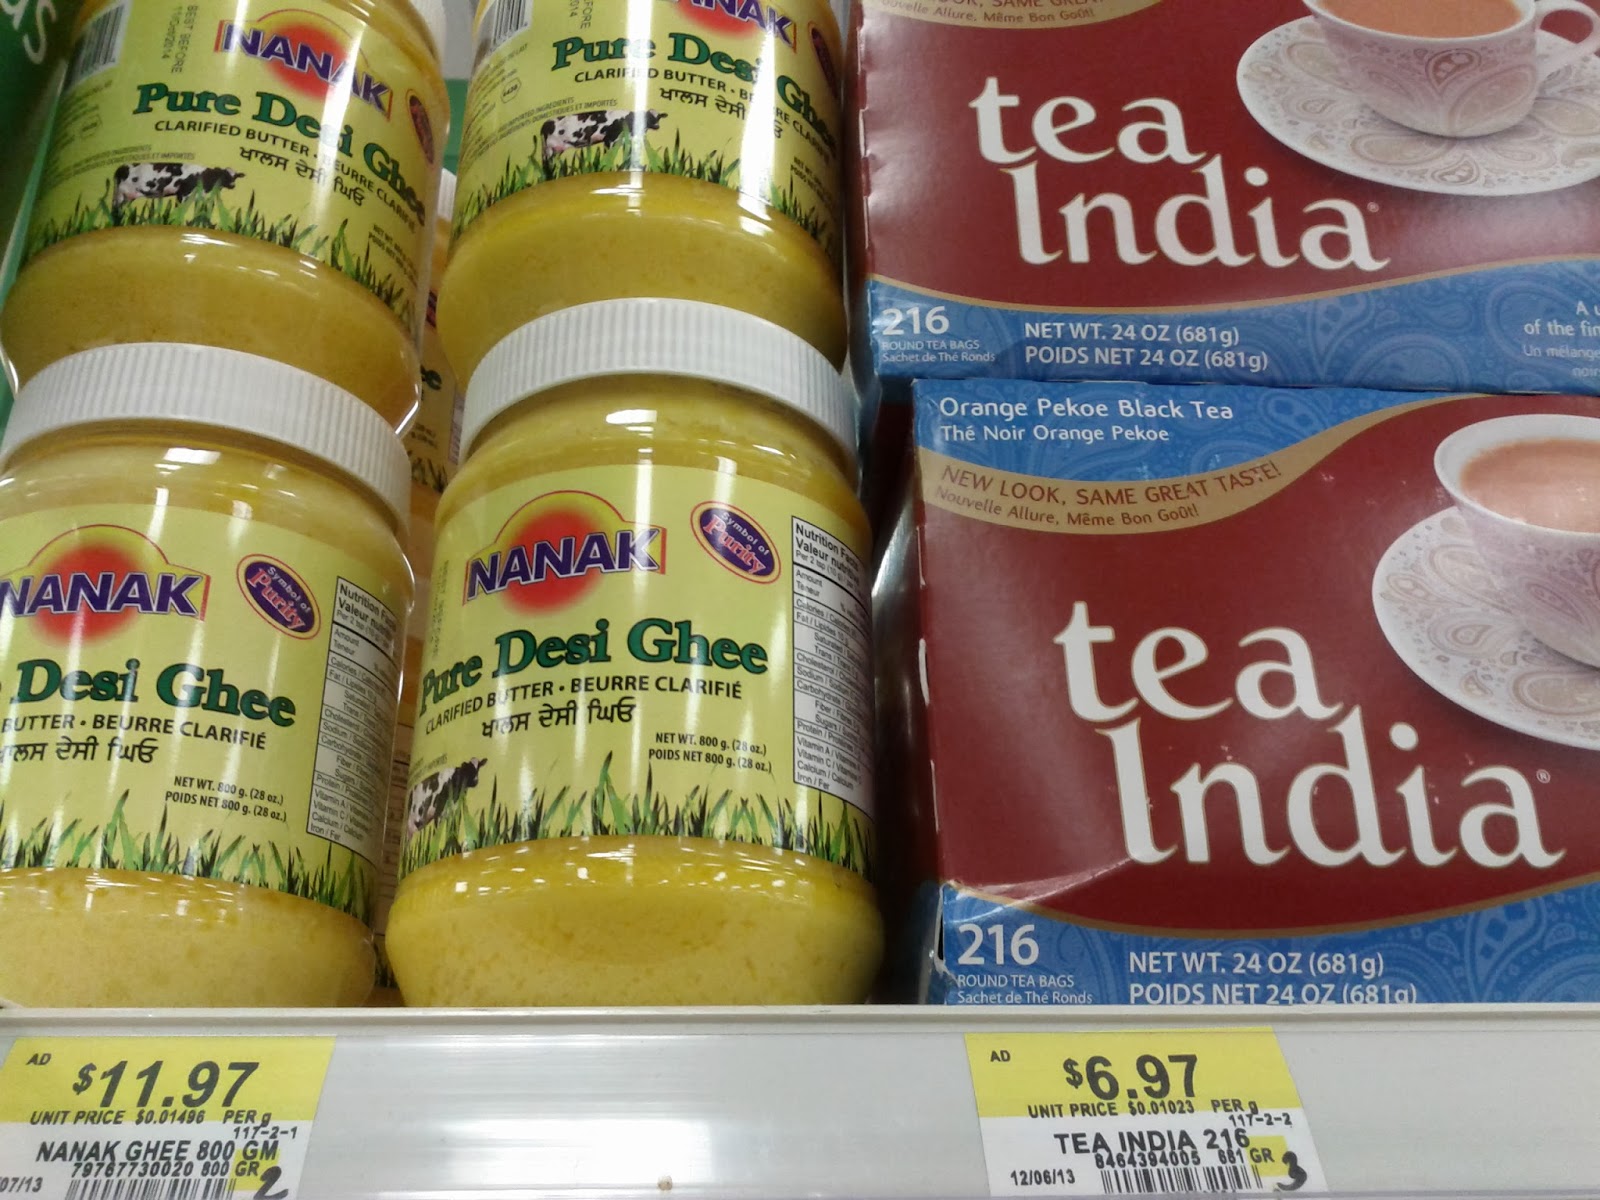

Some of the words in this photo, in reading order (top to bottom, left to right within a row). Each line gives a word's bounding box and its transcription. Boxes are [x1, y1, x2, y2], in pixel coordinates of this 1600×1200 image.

[222, 23, 389, 114] NANAK
[664, 69, 726, 93] BUTTER
[133, 82, 242, 115] Pure
[969, 76, 1206, 164] tea
[155, 120, 241, 137] CLARIFIED
[246, 128, 309, 157] BUTTER
[1000, 154, 1391, 272] India
[881, 305, 950, 336] 216
[1576, 300, 1590, 316] A
[1024, 322, 1065, 339] NET
[1070, 323, 1106, 341] WT.
[1113, 325, 1137, 341] 24
[1141, 325, 1171, 343] OZ
[1176, 326, 1239, 348] (681g)
[1523, 318, 1541, 335] of
[1547, 319, 1575, 336] the
[881, 351, 920, 363] Sachet
[921, 352, 936, 363] de
[937, 352, 959, 363] Thé
[960, 352, 996, 364] Ronds
[882, 340, 925, 350] ROUND
[927, 341, 949, 350] TEA
[950, 340, 980, 351] BAGS
[1024, 346, 1089, 365] POIDS
[1095, 348, 1135, 366] NET
[1139, 349, 1164, 366] 24
[1167, 349, 1200, 368] OZ
[1204, 350, 1269, 373] (681g)
[939, 397, 1028, 422] Orange
[1037, 397, 1109, 417] Pekoe
[1118, 399, 1183, 418] Black
[1190, 400, 1233, 420] Tea
[940, 424, 976, 442] Thé
[983, 425, 1026, 441] Noir
[1033, 425, 1104, 444] Orange
[1112, 425, 1170, 442] Pekoe
[940, 464, 995, 492] NEW
[1000, 479, 1066, 505] LOOK,
[1075, 487, 1138, 506] SAME
[1144, 479, 1209, 503] GREAT
[1214, 460, 1283, 490] TASTE!
[935, 485, 1003, 516] Nouvelle
[1007, 504, 1060, 526] Allure,
[1067, 510, 1115, 527] Même
[1122, 510, 1153, 526] Bon
[1157, 504, 1201, 522] Goût!
[720, 511, 758, 545] Symbol
[795, 522, 839, 555] Nutrition
[702, 513, 767, 575] Purity
[468, 527, 661, 599] NANAK
[0, 570, 203, 617] NANAK
[246, 568, 306, 630] Purity
[418, 655, 483, 718] Pure
[492, 618, 612, 678] Desi
[626, 618, 768, 675] Ghee
[1053, 600, 1344, 722] tea
[10, 658, 141, 704] Desi
[156, 662, 297, 728] Ghee
[425, 697, 484, 735] CLARIFIED
[487, 681, 554, 707] BUTTER
[571, 676, 650, 693] BEURRE
[654, 674, 743, 700] CLARIFIÉ
[1, 714, 76, 733] BUTTER
[92, 714, 174, 734] BEURRE
[179, 720, 267, 750] CLARIFIÉ
[655, 732, 676, 744] NET
[678, 734, 697, 746] WT.
[699, 735, 718, 747] 800
[720, 740, 730, 751] g.
[732, 739, 748, 752] (28
[749, 744, 767, 757] oz.)
[648, 748, 680, 761] POIDS
[683, 750, 703, 762] NET
[705, 752, 724, 764] 800
[726, 757, 736, 769] g.
[737, 756, 753, 769] (28
[755, 760, 772, 773] oz.)
[174, 775, 195, 788] NET
[197, 778, 215, 791] WT.
[217, 781, 237, 794] 800
[238, 788, 248, 799] g.
[249, 787, 265, 801] (28
[267, 794, 284, 806] oz.)
[1097, 705, 1567, 868] India
[165, 790, 197, 805] POIDS
[199, 795, 219, 808] NET
[221, 799, 240, 811] 800
[242, 805, 251, 816] g.
[253, 805, 269, 817] (28
[270, 811, 287, 822] oz.)
[957, 923, 1040, 966] 216
[957, 974, 1008, 988] ROUND
[1011, 975, 1034, 988] TEA
[1039, 974, 1075, 988] BAGS
[1129, 952, 1178, 973] NET
[1182, 952, 1226, 973] WT.
[1232, 952, 1261, 973] 24
[1267, 952, 1302, 974] OZ
[1309, 952, 1384, 979] (681g)
[957, 991, 1001, 1004] Sachet
[1005, 991, 1022, 1004] de
[1025, 991, 1049, 1004] Thé
[1052, 991, 1093, 1004] Ronds
[1129, 983, 1205, 1004] POIDS
[1212, 983, 1260, 1004] NET
[1265, 984, 1296, 1004] 24
[1301, 984, 1336, 1004] OZ
[1342, 984, 1417, 1004] (681g)
[26, 1053, 51, 1065] AD
[990, 1050, 1011, 1062] AD
[72, 1060, 260, 1108] $11.97
[1062, 1054, 1198, 1100] $6.97
[30, 1110, 67, 1125] UNIT
[73, 1110, 126, 1125] PRICE
[135, 1109, 207, 1125] $0.01496
[222, 1110, 258, 1124] PER
[260, 1111, 272, 1128] g
[1028, 1104, 1064, 1119] UNIT
[1070, 1102, 1118, 1117] PRICE
[1128, 1100, 1195, 1116] $0.01023
[1211, 1099, 1245, 1113] PER
[1248, 1100, 1259, 1116] g
[1228, 1113, 1293, 1127] 117-2-2
[232, 1126, 298, 1140] 117-2-1
[1053, 1132, 1112, 1155] TEA
[1118, 1129, 1196, 1152] INDIA
[1203, 1127, 1250, 1150] 216
[36, 1141, 118, 1162] NANAK
[125, 1140, 192, 1161] GHEE
[196, 1139, 236, 1161] 800
[242, 1140, 280, 1161] GM
[1218, 1149, 1245, 1165] 681
[1249, 1147, 1275, 1164] GR
[71, 1161, 194, 1178] 79767730020
[200, 1160, 230, 1176] 800
[235, 1161, 260, 1177] GR
[253, 1165, 289, 1200] 2
[1010, 1168, 1076, 1187] 12/06/13
[1277, 1150, 1308, 1192] 3
